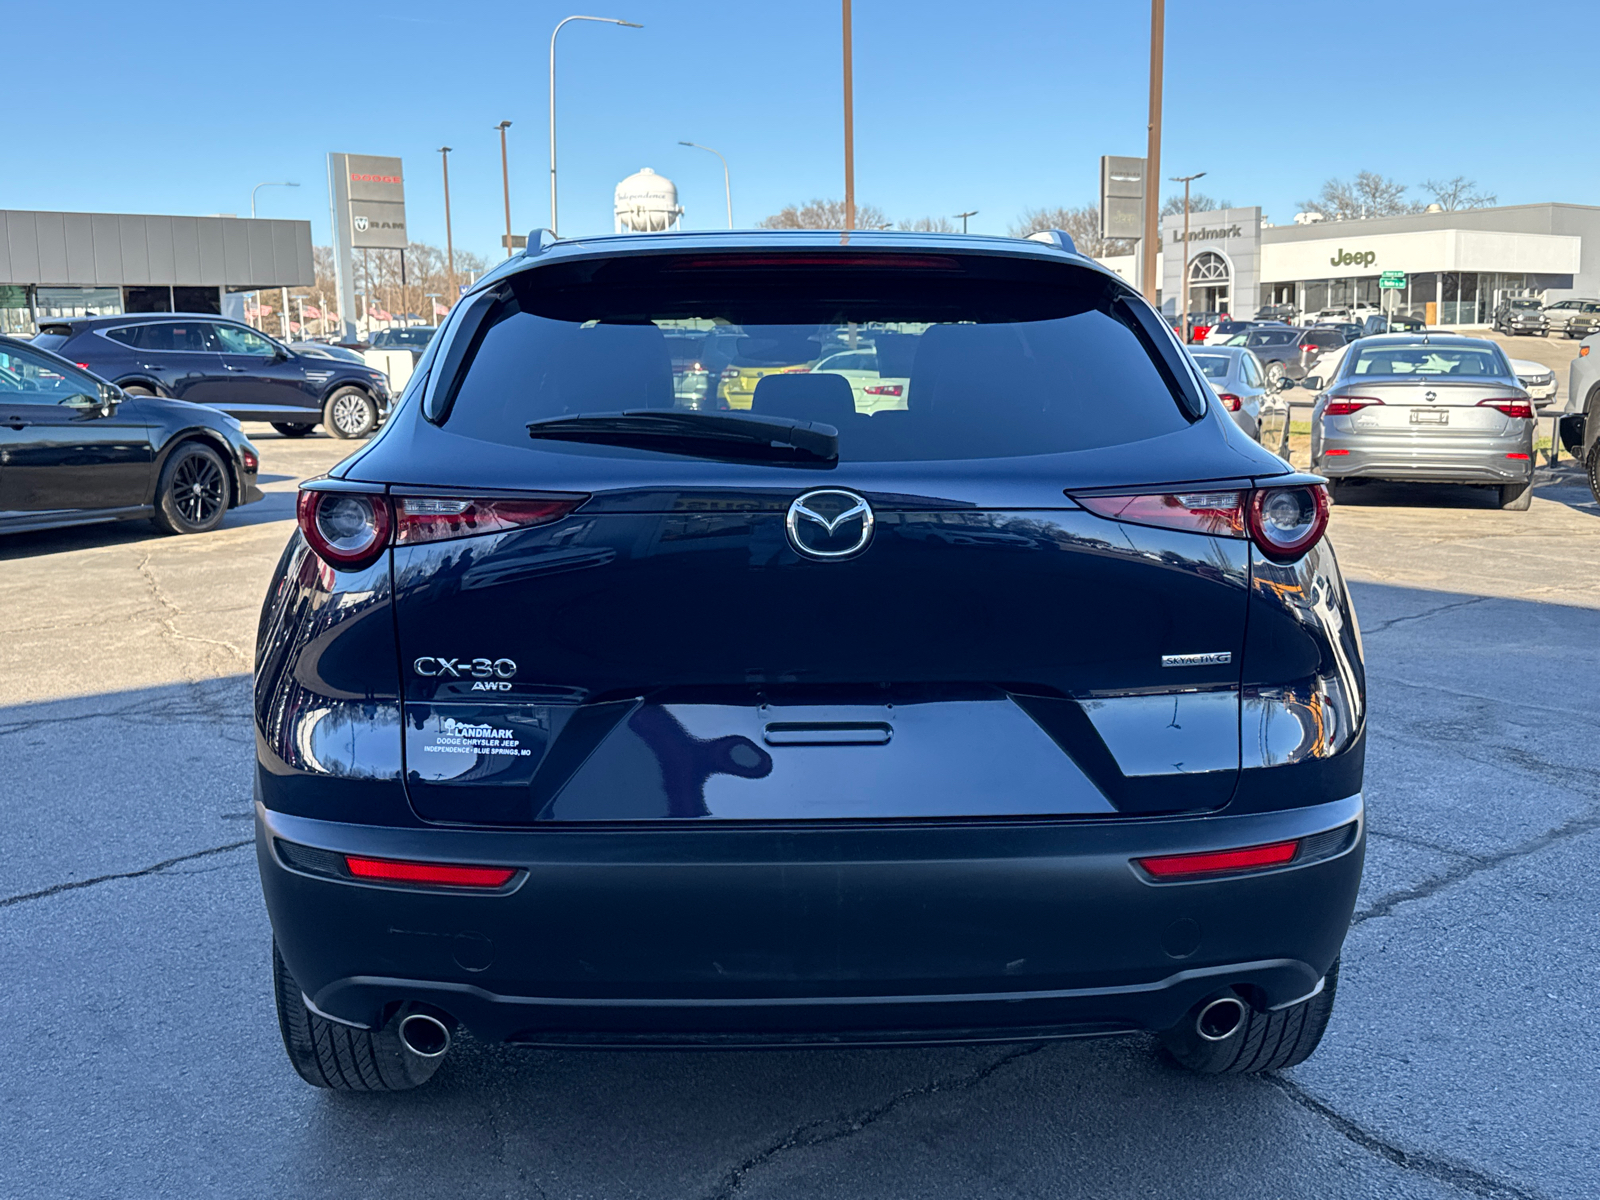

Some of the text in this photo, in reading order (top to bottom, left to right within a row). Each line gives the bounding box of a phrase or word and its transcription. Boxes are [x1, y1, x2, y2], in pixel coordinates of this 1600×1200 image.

[351, 173, 401, 184] DODGE
[370, 222, 404, 230] RAM
[1330, 248, 1376, 269] Jeep
[413, 656, 517, 679] CX-30
[471, 681, 512, 691] AWD
[455, 729, 513, 738] LANDMARK
[462, 738, 500, 747] CHRYSLER
[501, 739, 520, 748] JEEP
[424, 746, 532, 757] INDEPENDENCE BLUE SPRINGS, MO
